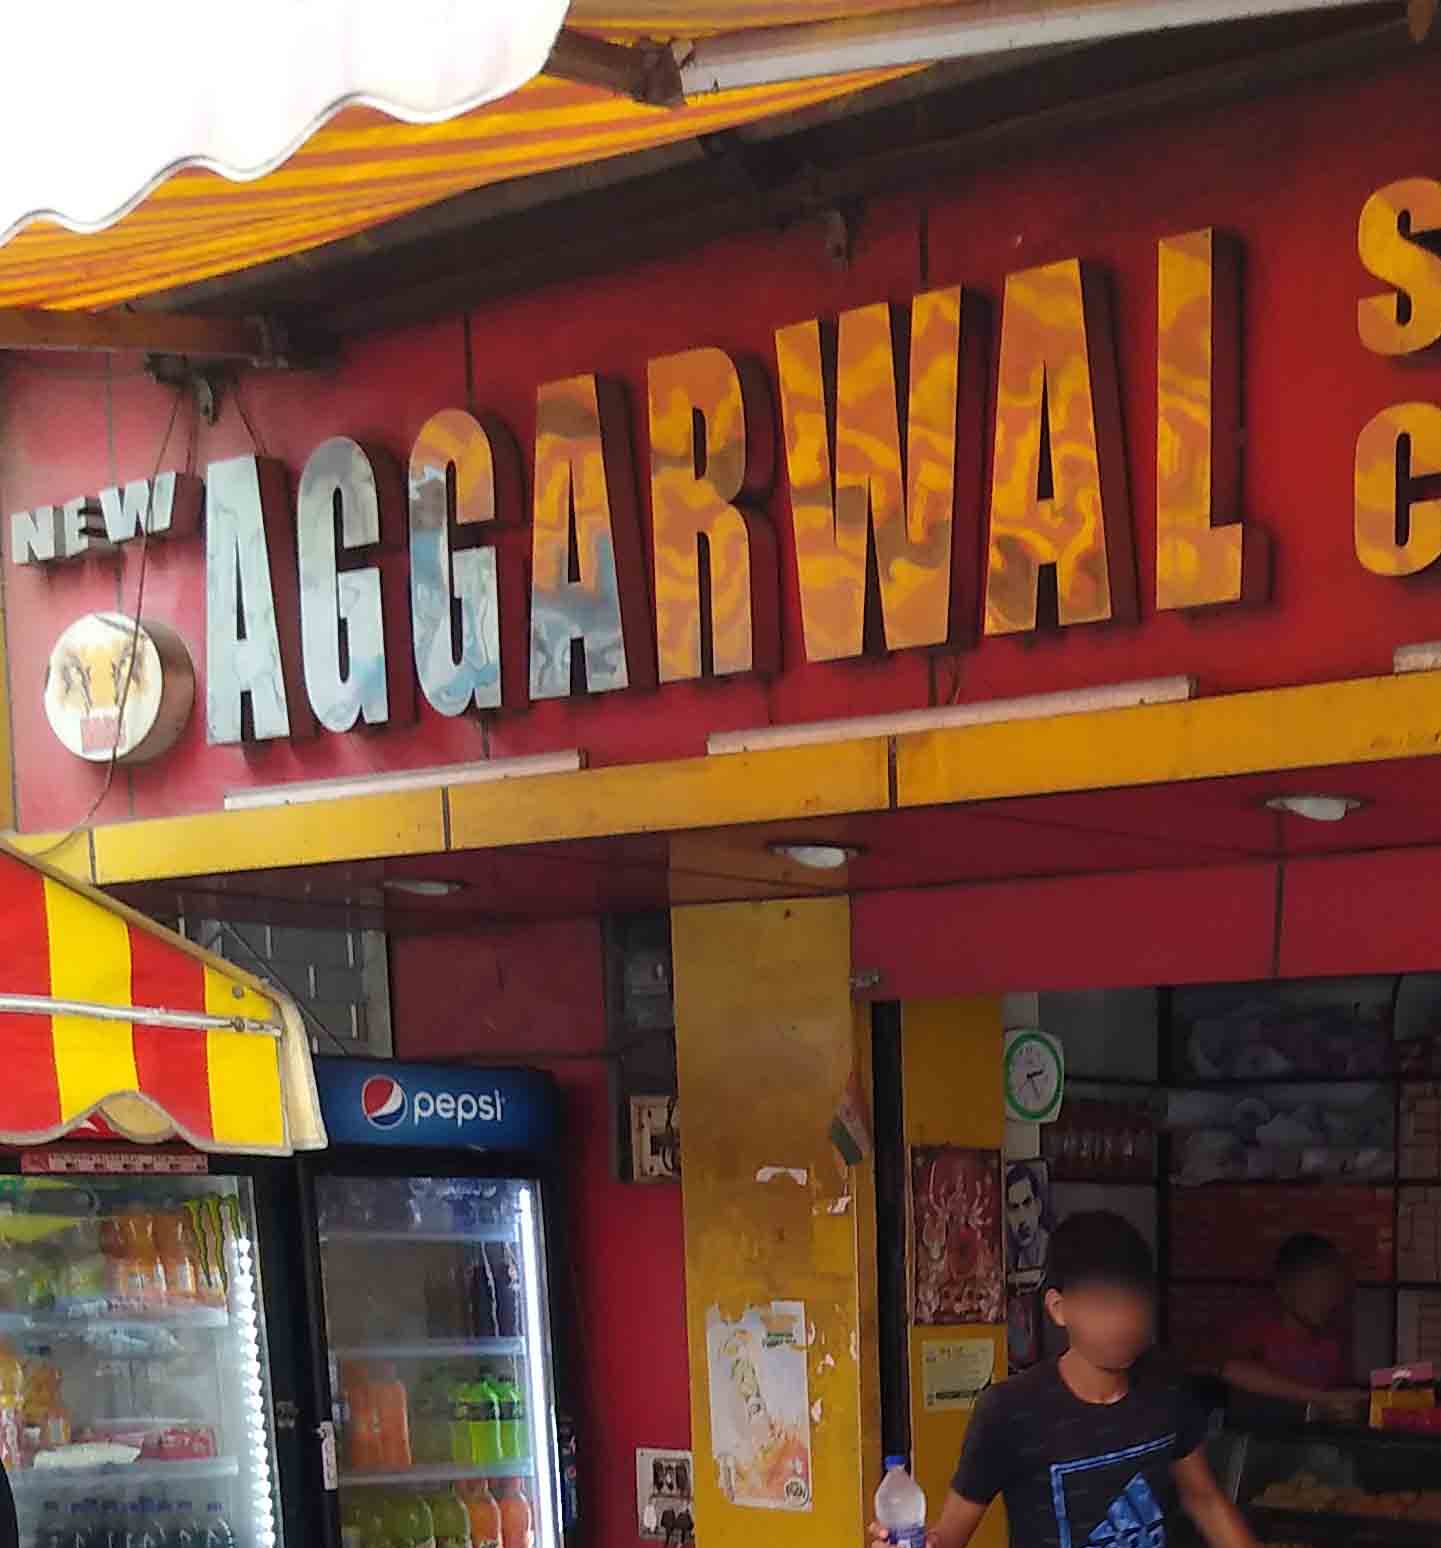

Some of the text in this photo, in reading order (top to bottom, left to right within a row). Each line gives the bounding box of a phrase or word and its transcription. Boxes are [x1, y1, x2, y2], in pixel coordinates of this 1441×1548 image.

[11, 227, 1243, 746] NEW AGGARWAL
[413, 1089, 502, 1128] pepsi
